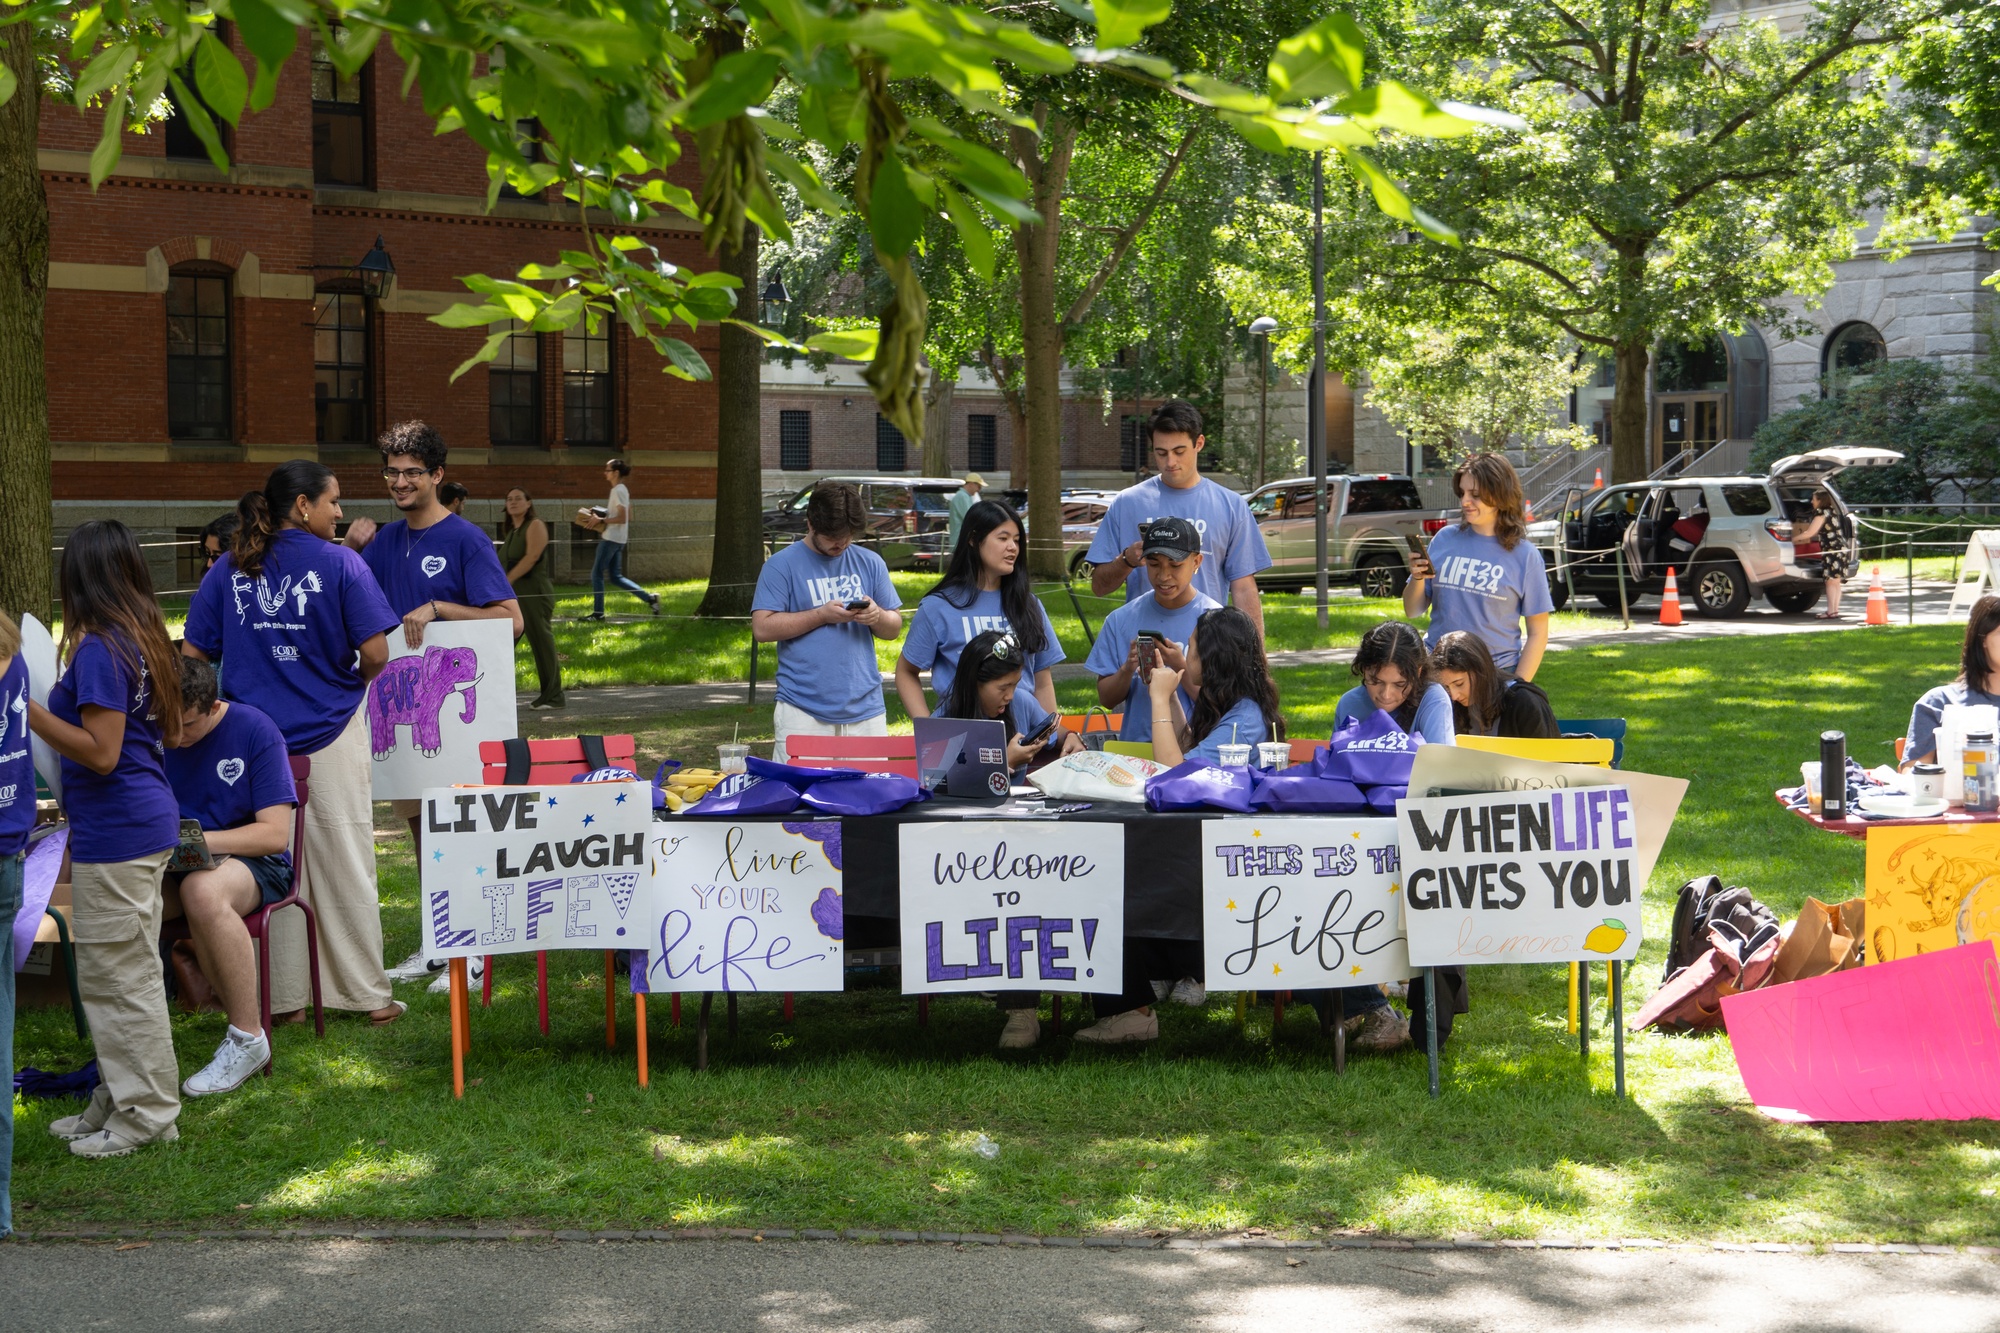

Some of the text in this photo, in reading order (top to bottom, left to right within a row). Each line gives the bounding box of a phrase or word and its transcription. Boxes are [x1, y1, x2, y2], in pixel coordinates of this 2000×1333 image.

[1439, 556, 1504, 588] LIFE 20
[1475, 575, 1499, 594] 24
[806, 573, 861, 607] LIFE 20
[0, 784, 17, 800] OOP
[582, 769, 618, 783] LIFE
[720, 773, 752, 798] LIFE
[428, 791, 541, 833] LIVE
[1408, 789, 1633, 852] WHEN LIFE
[496, 832, 645, 879] LAUGH
[715, 826, 814, 882] live
[1216, 843, 1400, 878] THIS IS TH
[691, 884, 782, 914] YOUR
[992, 891, 1021, 908] TO
[1407, 858, 1632, 910] GIVES YOU
[430, 872, 640, 949] LIFE!
[1224, 885, 1407, 976] Life
[925, 916, 1099, 984] LIFE!
